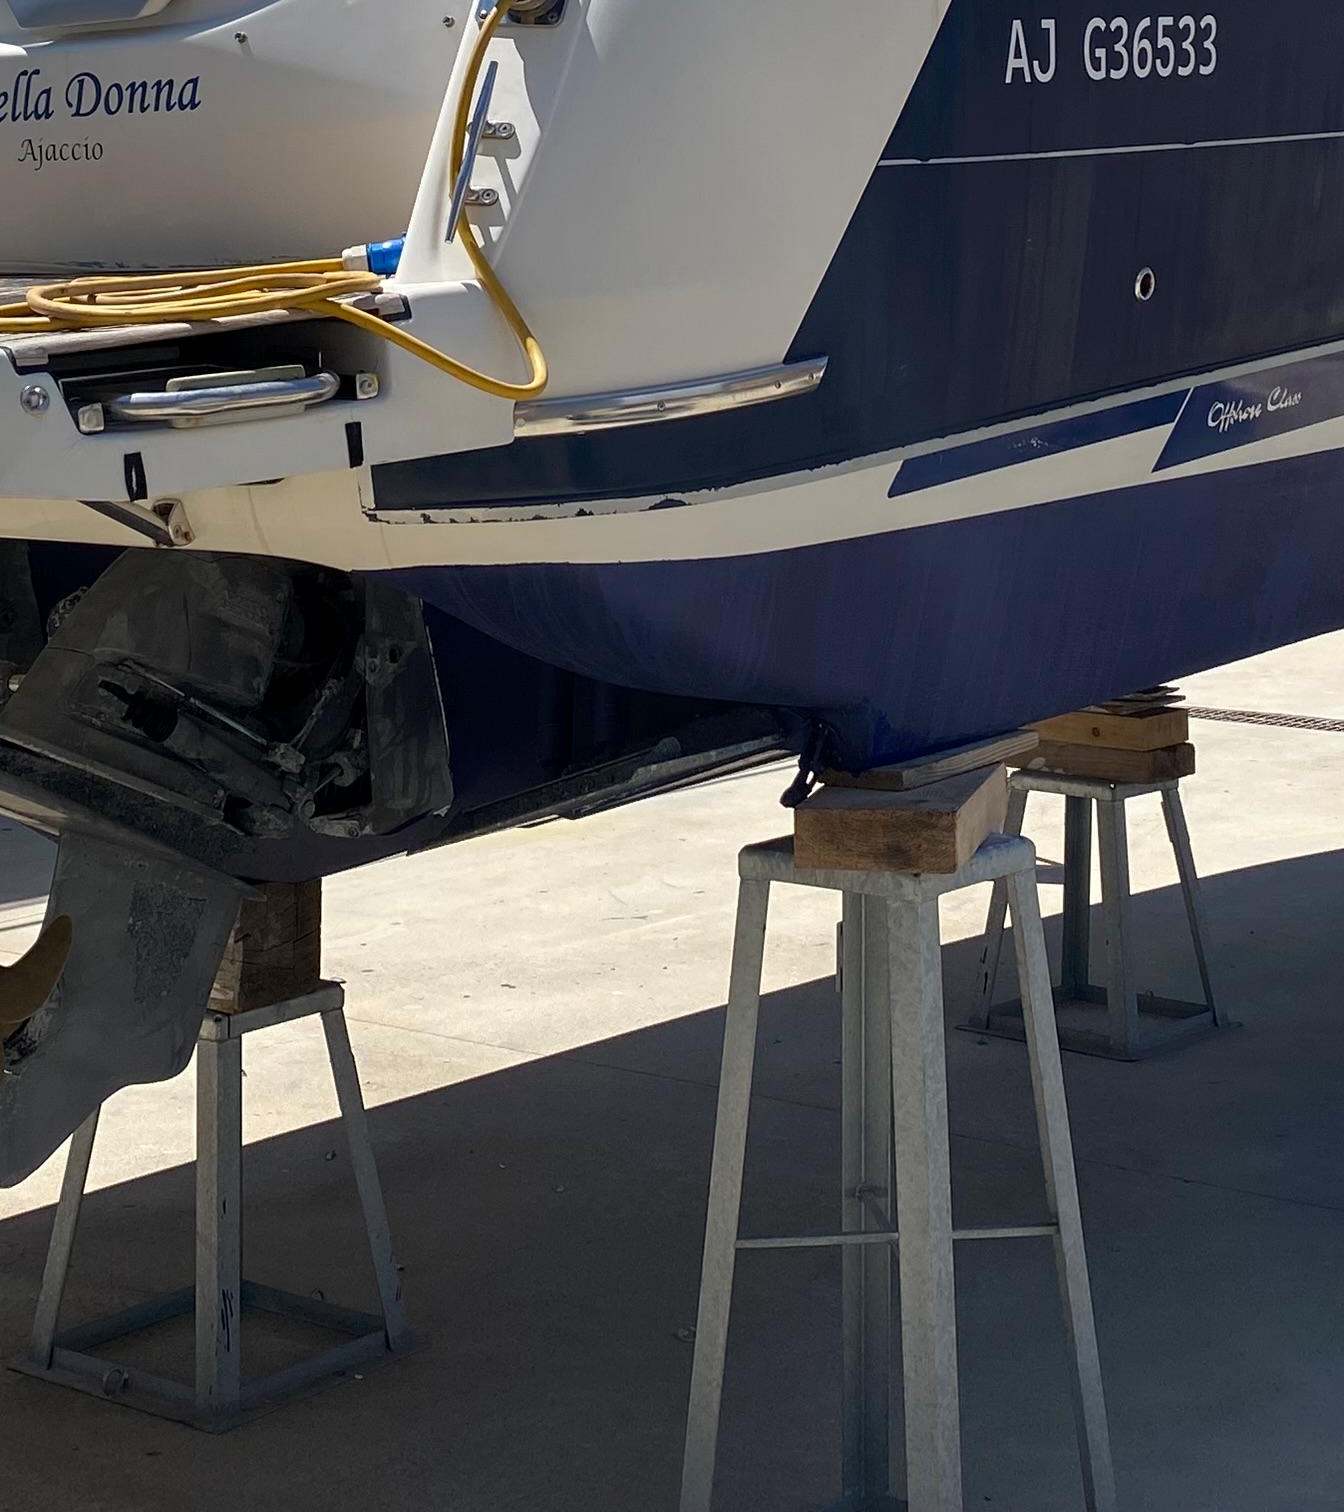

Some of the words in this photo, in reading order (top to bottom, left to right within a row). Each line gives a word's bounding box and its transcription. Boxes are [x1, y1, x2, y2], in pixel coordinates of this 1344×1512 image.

[1004, 18, 1057, 85] AJ
[1083, 14, 1219, 82] G36533
[65, 71, 202, 120] Donna
[17, 136, 105, 171] Ajaccio
